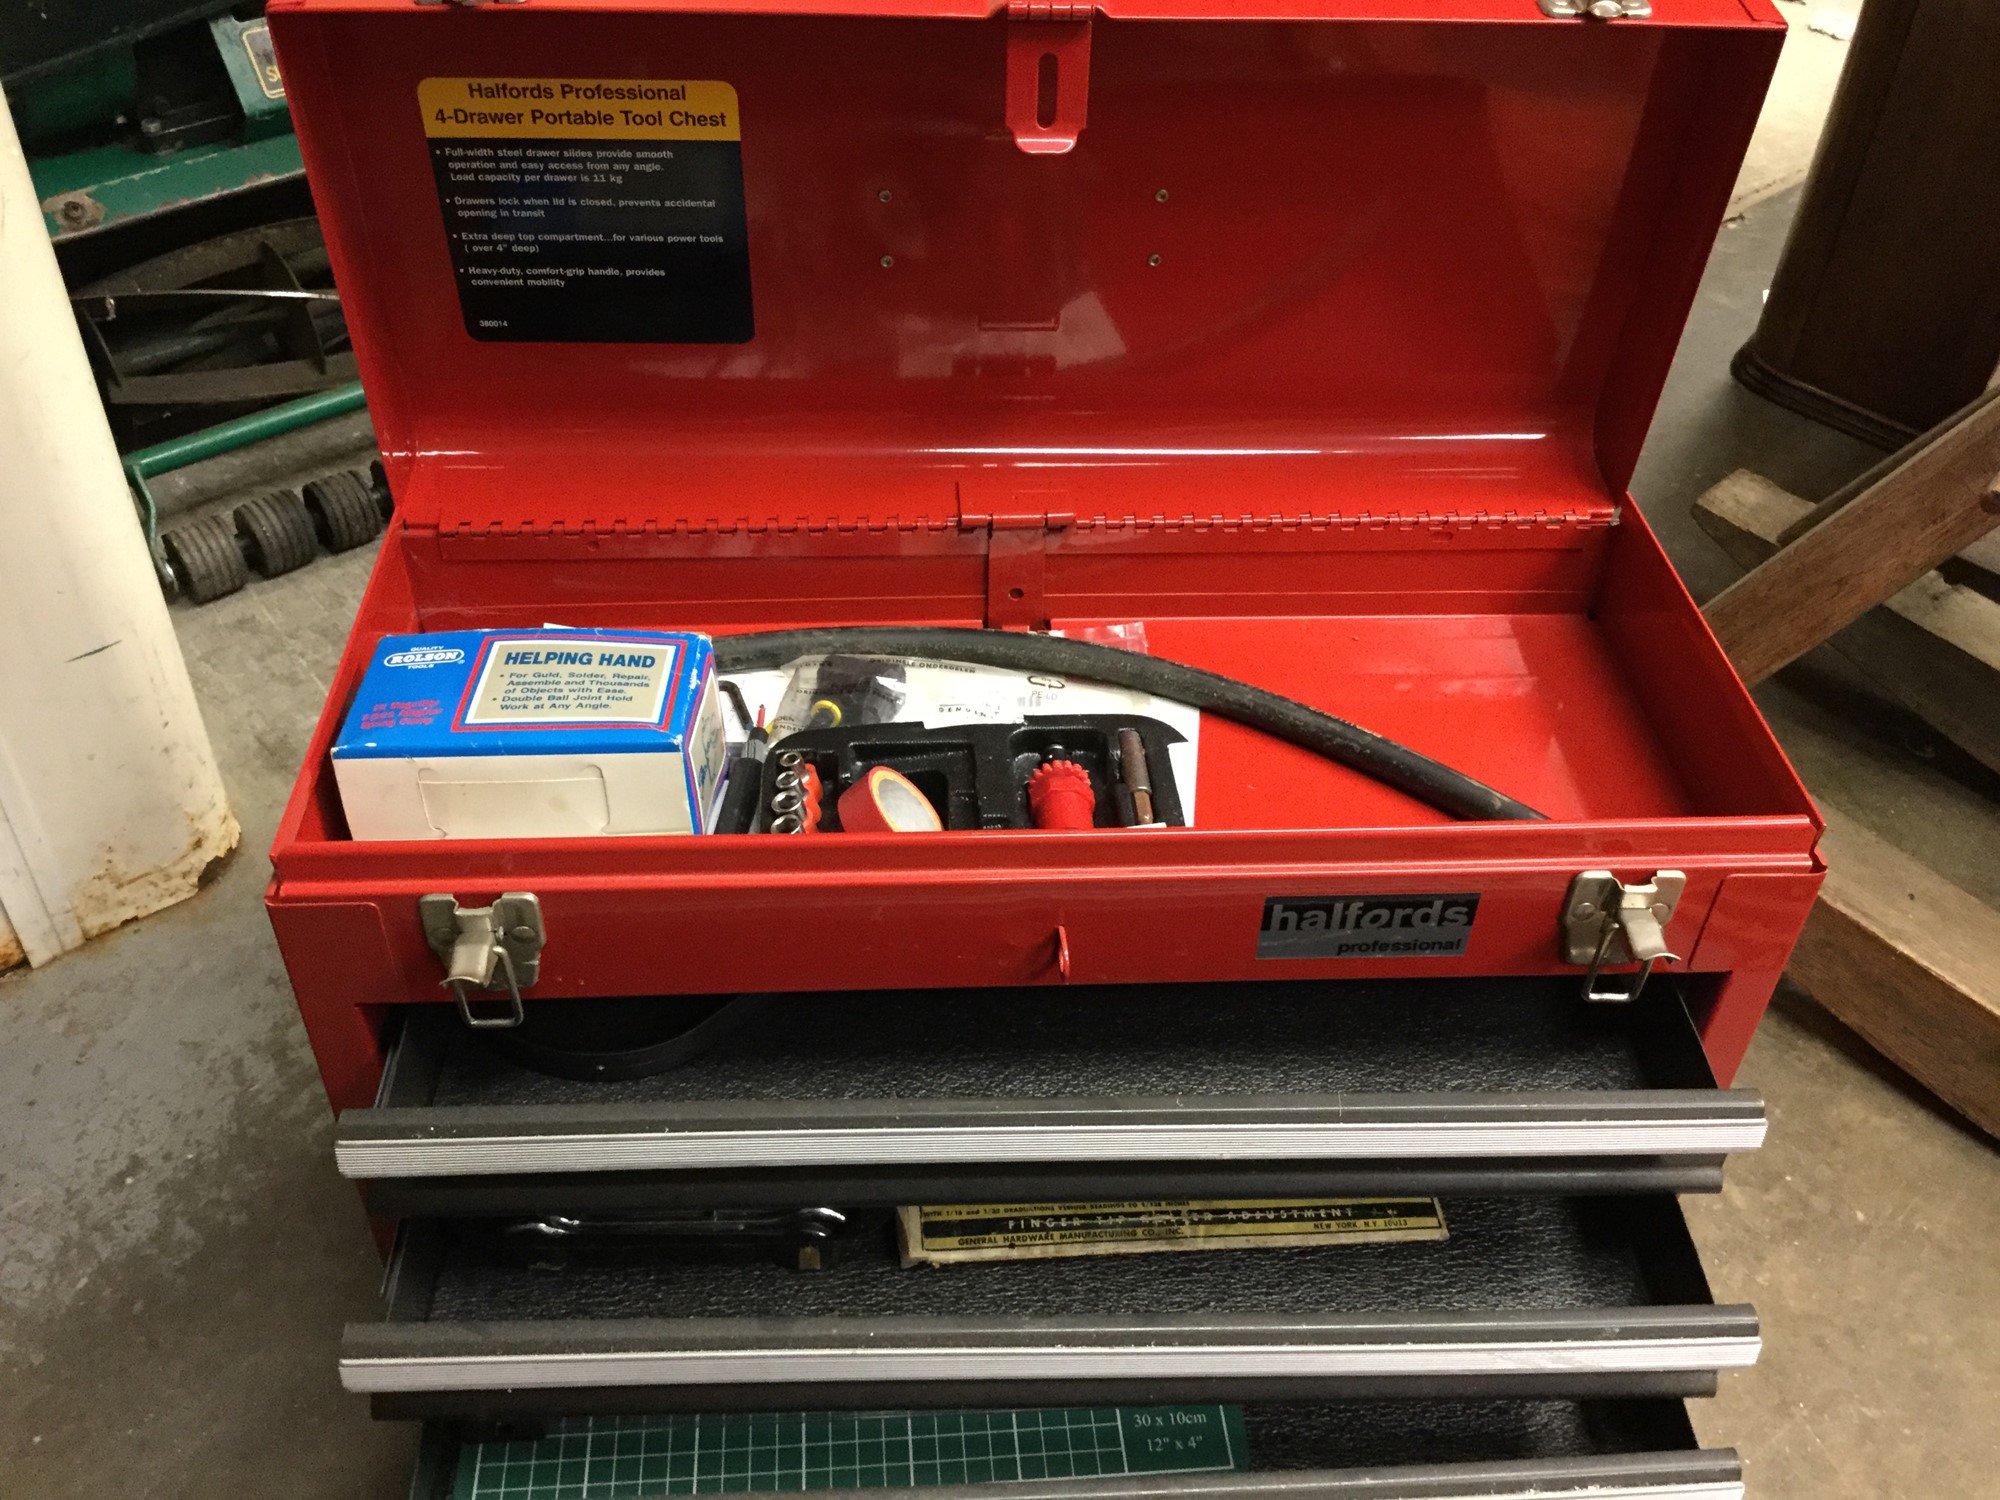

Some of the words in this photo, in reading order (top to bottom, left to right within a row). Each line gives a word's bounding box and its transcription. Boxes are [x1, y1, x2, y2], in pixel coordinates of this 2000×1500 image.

[468, 83, 554, 100] Halfords
[560, 83, 686, 101] Professional
[435, 109, 524, 124] 4-Drawer
[531, 110, 614, 126] Portable
[620, 110, 663, 126] Tool
[668, 111, 726, 128] Chest
[445, 148, 494, 157] Full-width
[497, 148, 523, 157] steel
[526, 149, 560, 157] drawer
[563, 149, 593, 158] slides
[596, 149, 632, 159] provide
[635, 150, 674, 159] smooth
[448, 161, 496, 171] operation
[499, 161, 518, 169] and
[521, 162, 544, 171] easy
[587, 162, 610, 171] from
[613, 163, 630, 172] any
[634, 163, 664, 172] angle.
[450, 173, 474, 181] Load
[478, 173, 520, 183] capacity
[524, 175, 540, 183] per
[543, 174, 577, 182] drawer
[580, 174, 590, 182] is
[593, 174, 606, 183] 11
[609, 174, 623, 184] kg
[454, 196, 495, 205] Drawers
[498, 197, 520, 206] lock
[523, 197, 550, 206] when
[552, 197, 565, 206] lid
[568, 197, 577, 206] is
[580, 198, 616, 207] closed,
[618, 198, 661, 208] prevents
[664, 199, 716, 208] accidental
[458, 209, 497, 218] opening
[500, 209, 509, 217] in
[512, 209, 545, 217] transit
[461, 232, 488, 241] Extra
[492, 233, 515, 243] deep
[518, 233, 535, 243] top
[629, 234, 664, 242] various
[667, 235, 696, 244] power
[700, 234, 723, 243] tools
[496, 243, 508, 253] 4"
[511, 243, 539, 254] deep)
[526, 267, 585, 278] comfort-grip
[588, 268, 623, 277] handle,
[626, 268, 665, 278] provides
[471, 278, 524, 286] convenient
[527, 278, 565, 288] mobility
[390, 652, 458, 664] ROLSON
[504, 652, 594, 666] HELPING
[598, 653, 656, 669] HAND
[588, 680, 650, 688] Thousands
[1269, 900, 1470, 932] halfords
[1337, 939, 1461, 956] professional
[1008, 1217, 1081, 1230] FINGER
[1227, 1208, 1354, 1220] ADJUSTMENT
[1313, 1222, 1332, 1231] NEW
[958, 1236, 998, 1246] GENERAL
[1003, 1232, 1055, 1244] HARDWARE
[1059, 1229, 1137, 1241] MANUFACTURING
[1164, 1227, 1184, 1236] INC.
[1133, 1413, 1151, 1428] 30
[1155, 1416, 1164, 1426] x
[1169, 1411, 1207, 1426] 10cm
[1147, 1436, 1170, 1452] 12"
[1175, 1440, 1184, 1450] x
[1187, 1435, 1203, 1449] 4"
